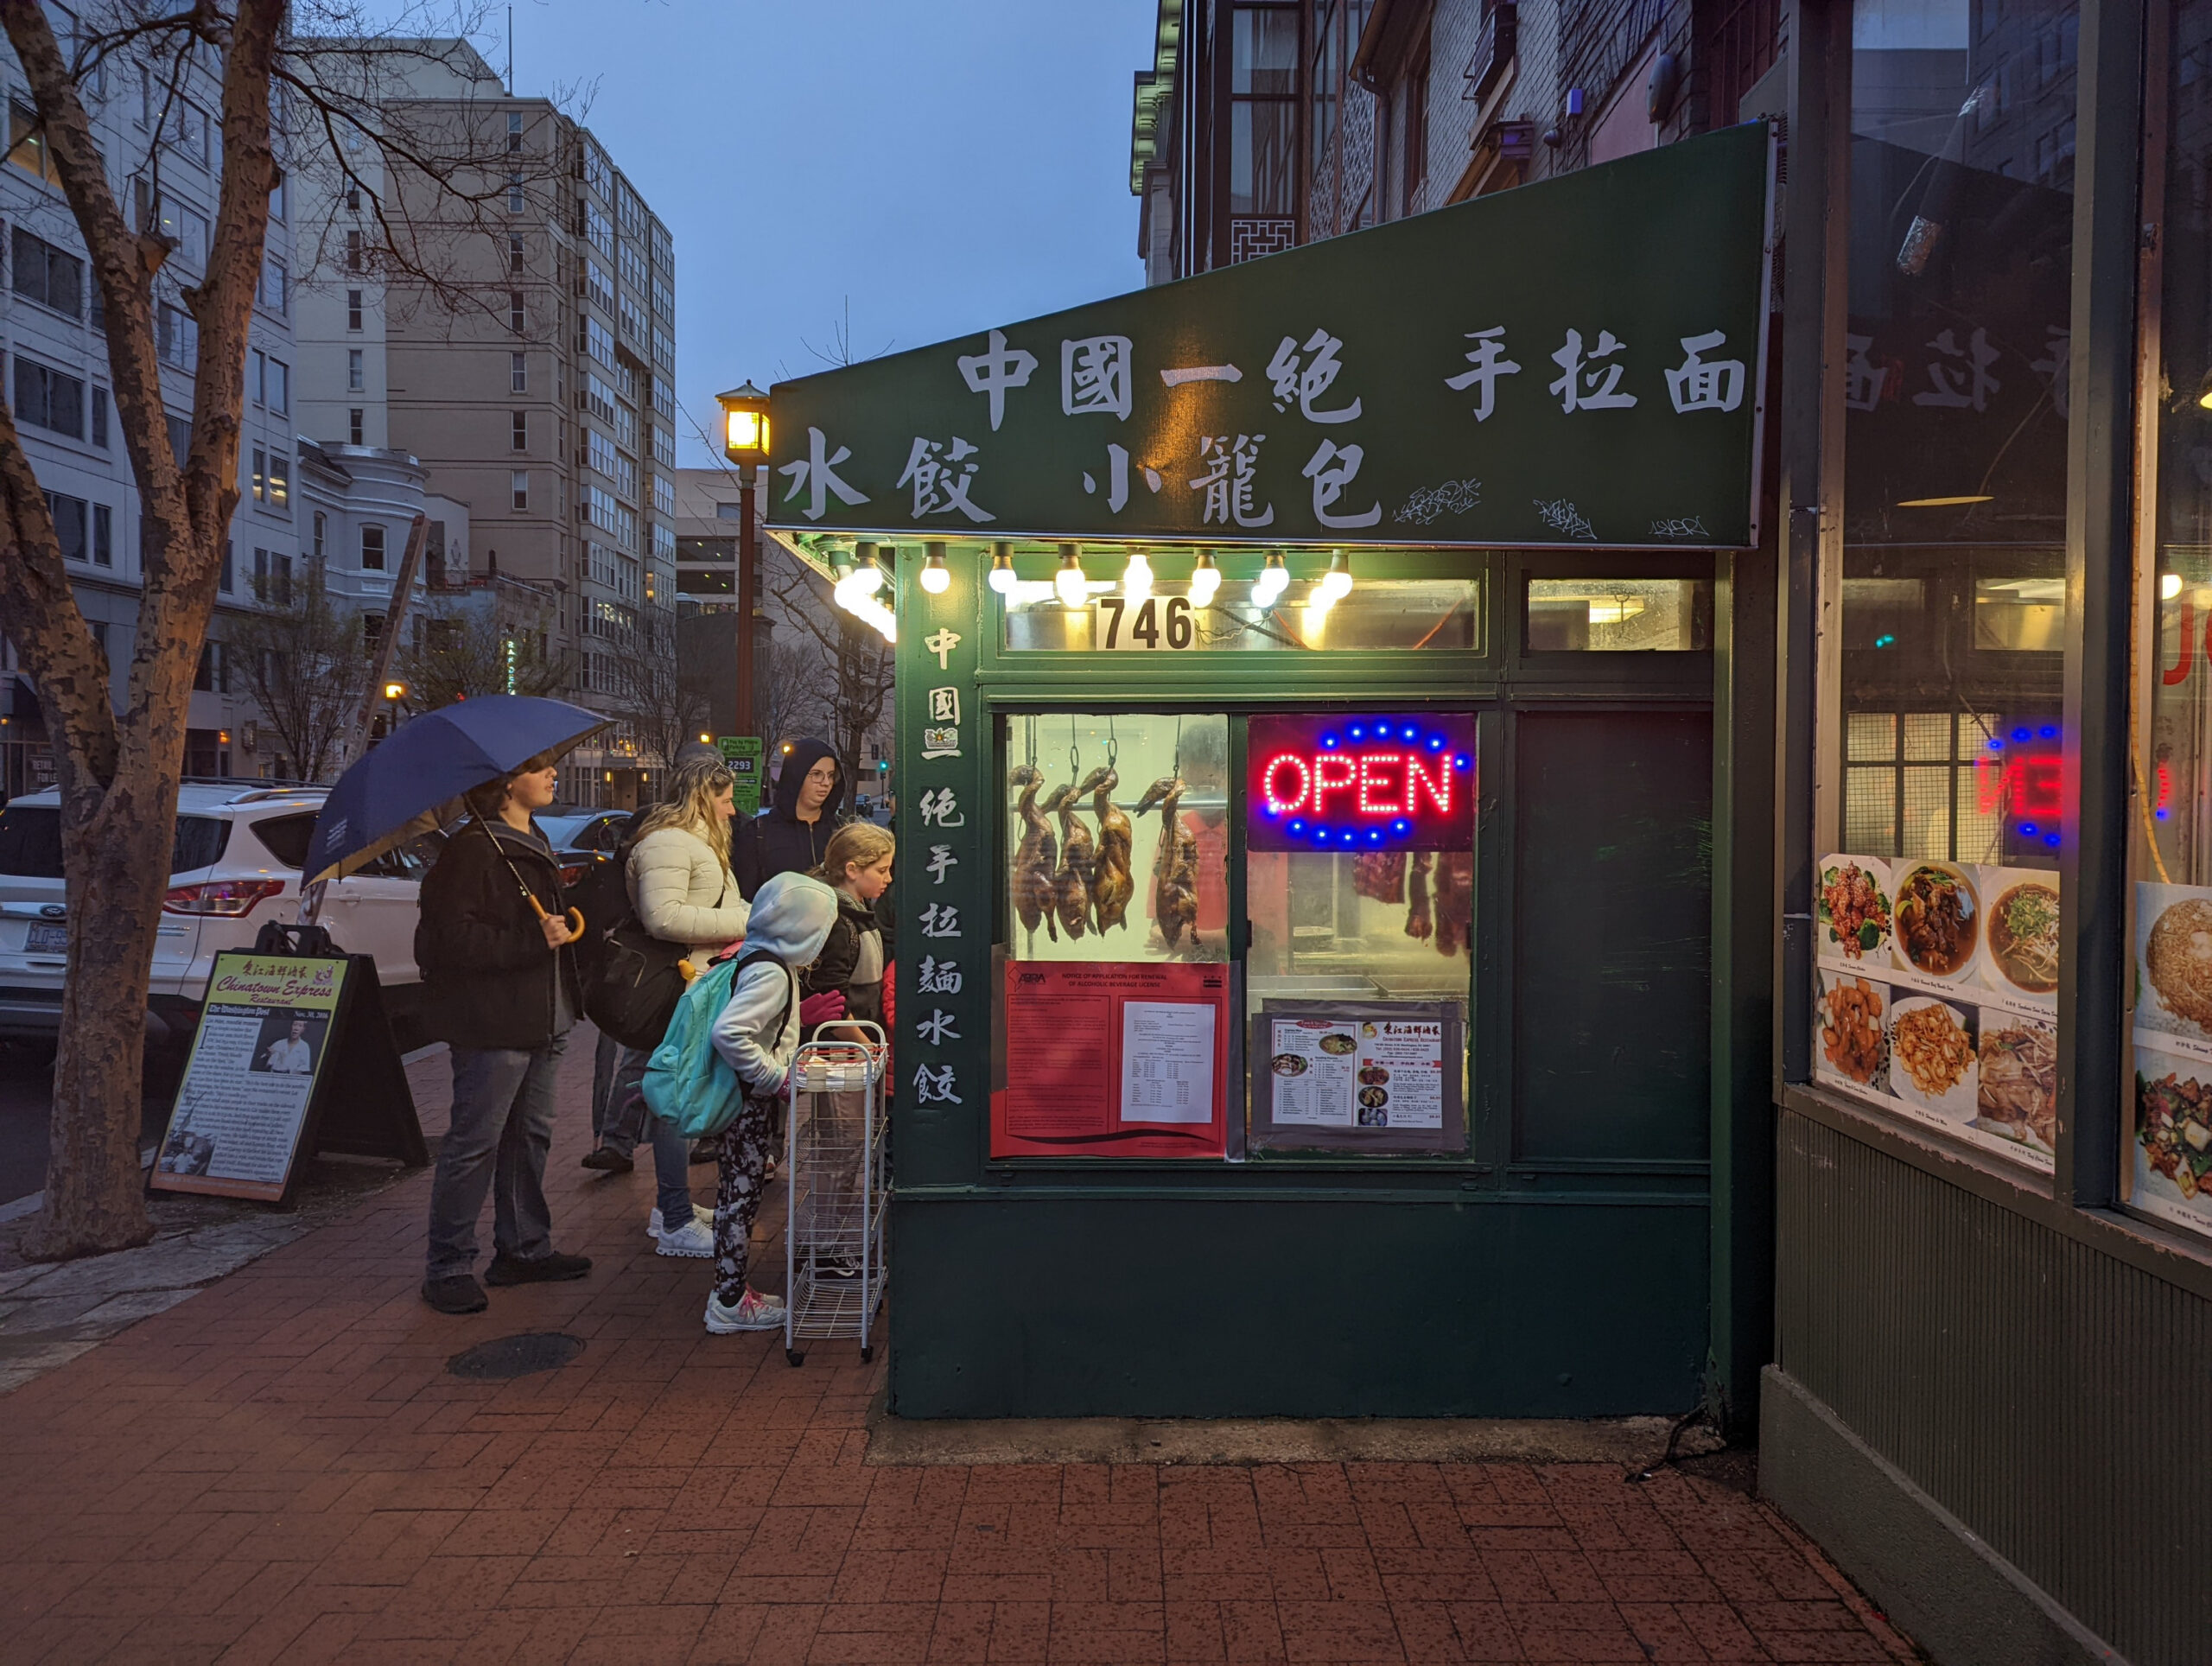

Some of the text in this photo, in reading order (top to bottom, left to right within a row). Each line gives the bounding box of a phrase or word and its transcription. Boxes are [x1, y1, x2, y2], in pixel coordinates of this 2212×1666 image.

[1444, 325, 1745, 423] 手拉面
[1099, 597, 1192, 650] 746
[728, 760, 751, 770] 2293
[1264, 754, 1451, 812] OPEN
[1018, 973, 1046, 983] ABRA
[216, 976, 333, 997] Chinatown Express
[249, 994, 294, 1005] Restaurant
[221, 1004, 255, 1015] Washington
[255, 1007, 270, 1016] Post
